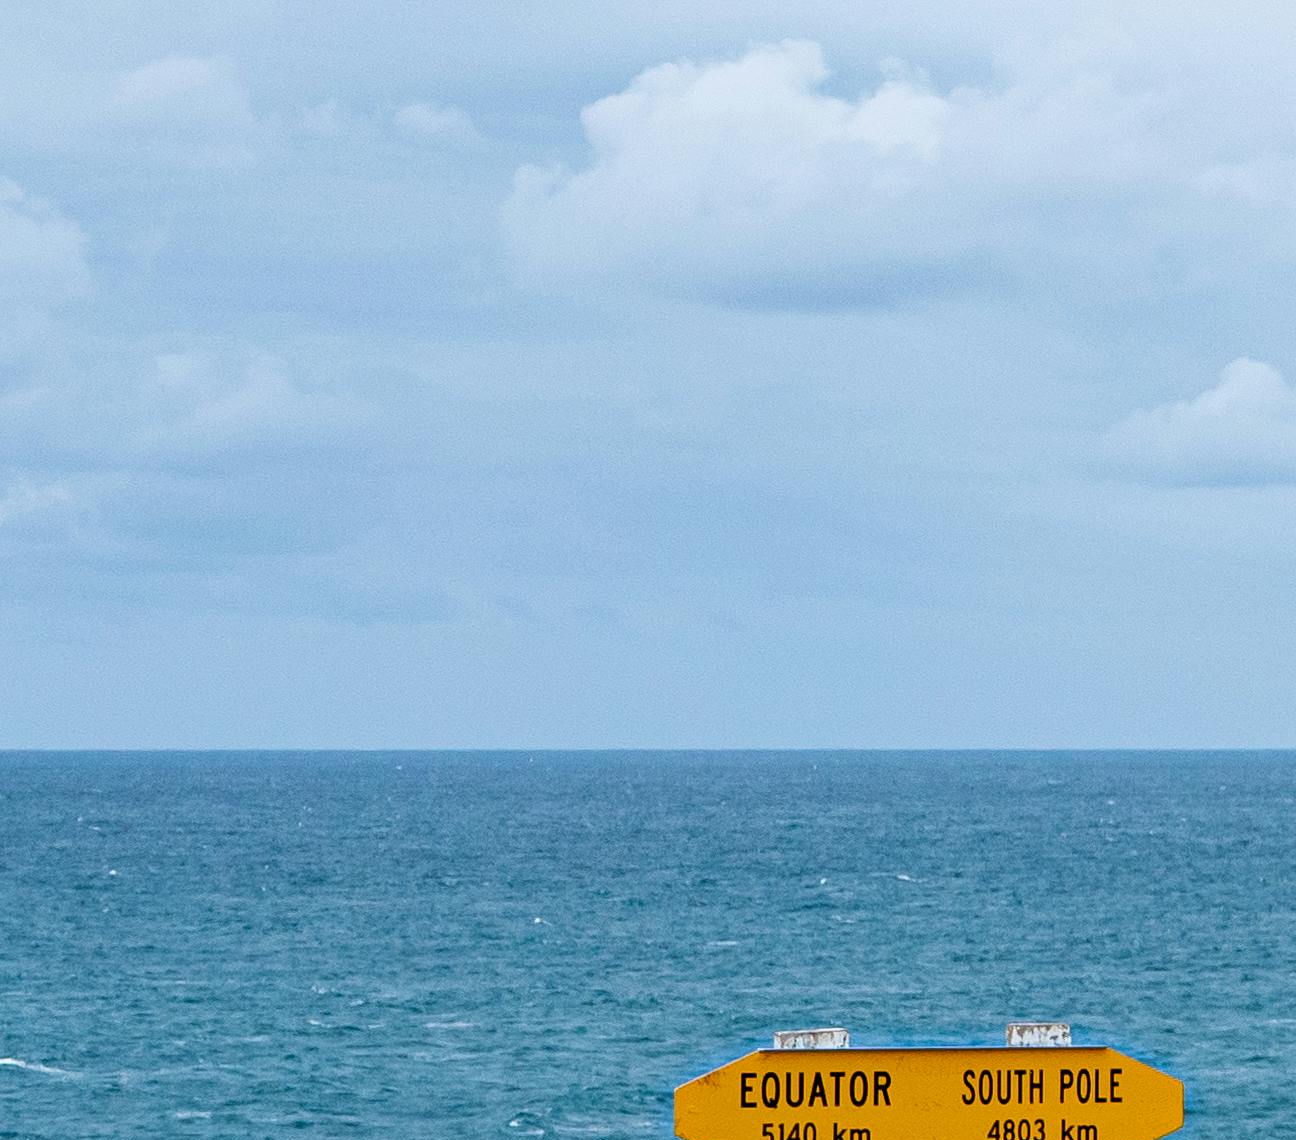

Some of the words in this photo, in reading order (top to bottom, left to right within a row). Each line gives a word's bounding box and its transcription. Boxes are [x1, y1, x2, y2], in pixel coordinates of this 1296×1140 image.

[740, 1070, 892, 1109] EQUATOR
[961, 1069, 1044, 1105] SOUTH
[1059, 1068, 1122, 1103] POLE
